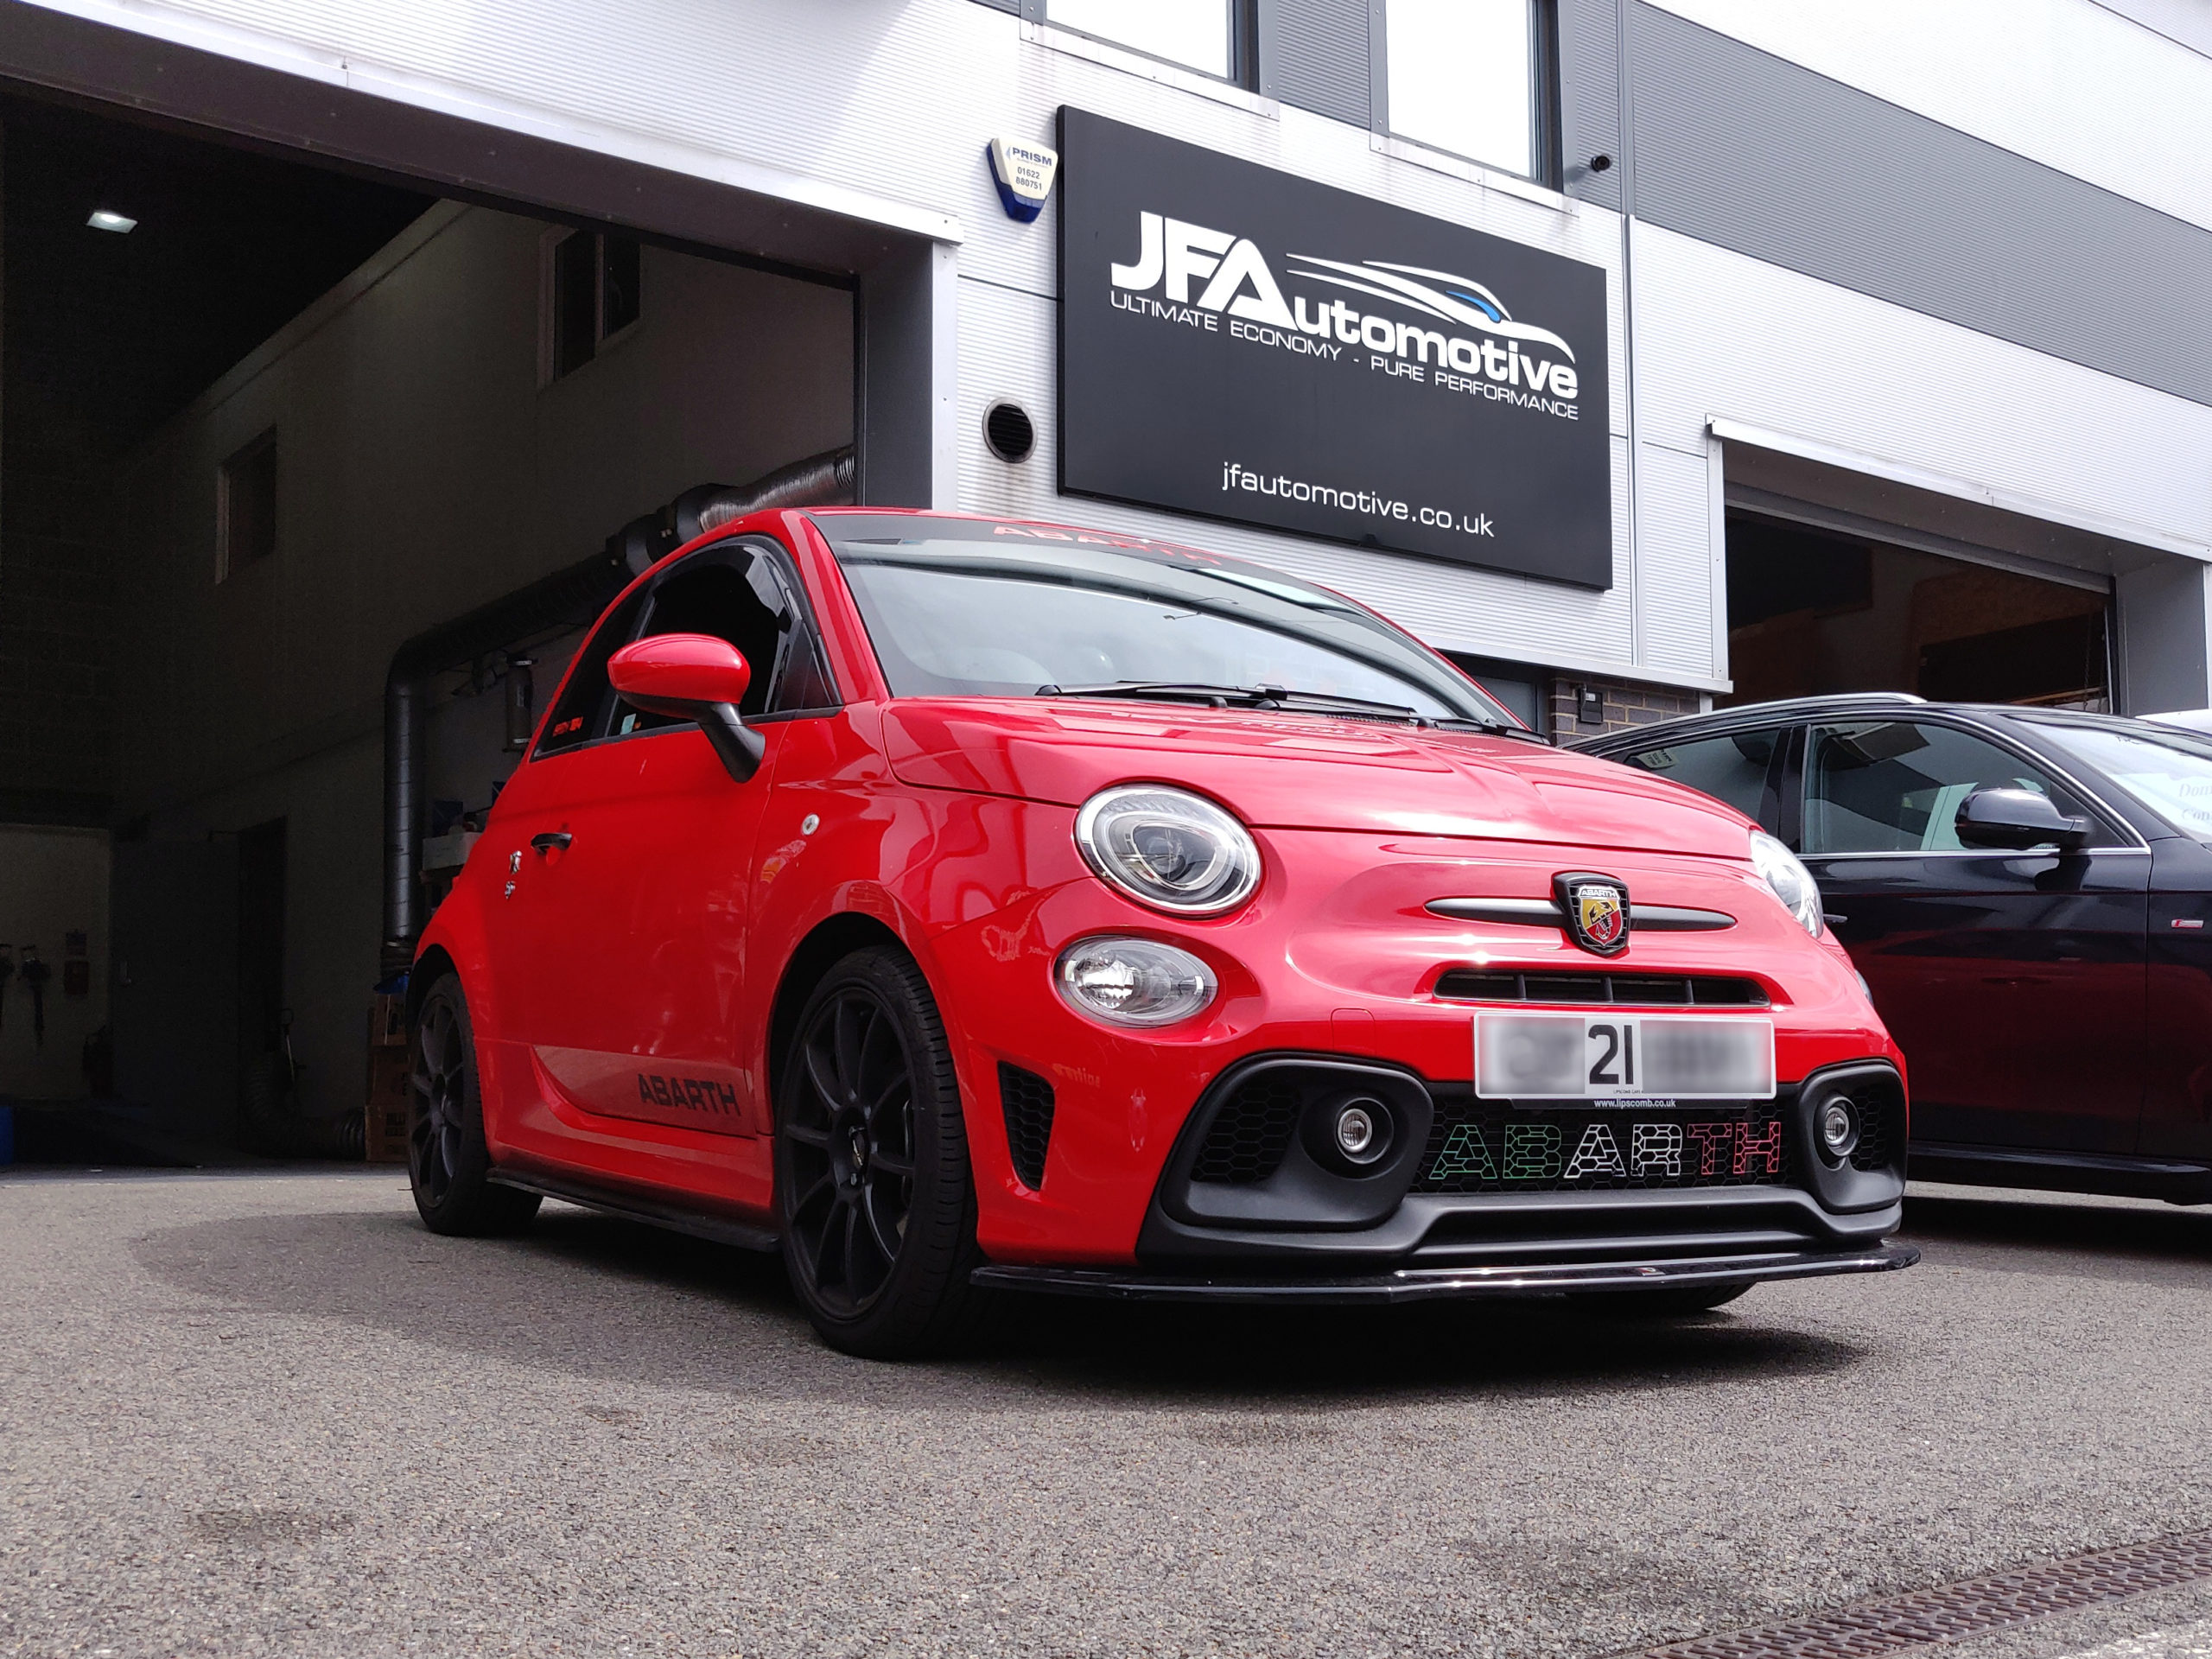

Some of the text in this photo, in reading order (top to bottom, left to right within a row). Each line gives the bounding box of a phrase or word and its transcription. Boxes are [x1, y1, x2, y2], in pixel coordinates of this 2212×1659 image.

[1012, 147, 1052, 167] PRISM
[1017, 167, 1040, 180] 01622
[1110, 210, 1580, 400] JFAutomotive
[1110, 289, 1218, 332] ULTIMATE
[1230, 320, 1342, 361] ECONOMY
[1370, 354, 1425, 383] PURE
[1434, 371, 1579, 421] PERFORMANCE
[1222, 461, 1495, 537] jfautomotive.co.uk
[1581, 889, 1618, 898] ABARTH
[1587, 1023, 1635, 1086] 21
[638, 1072, 742, 1117] ABARTH
[1593, 1098, 1677, 1109] www.lipscomb.co.uk
[1427, 1121, 1783, 1181] ABARTH
